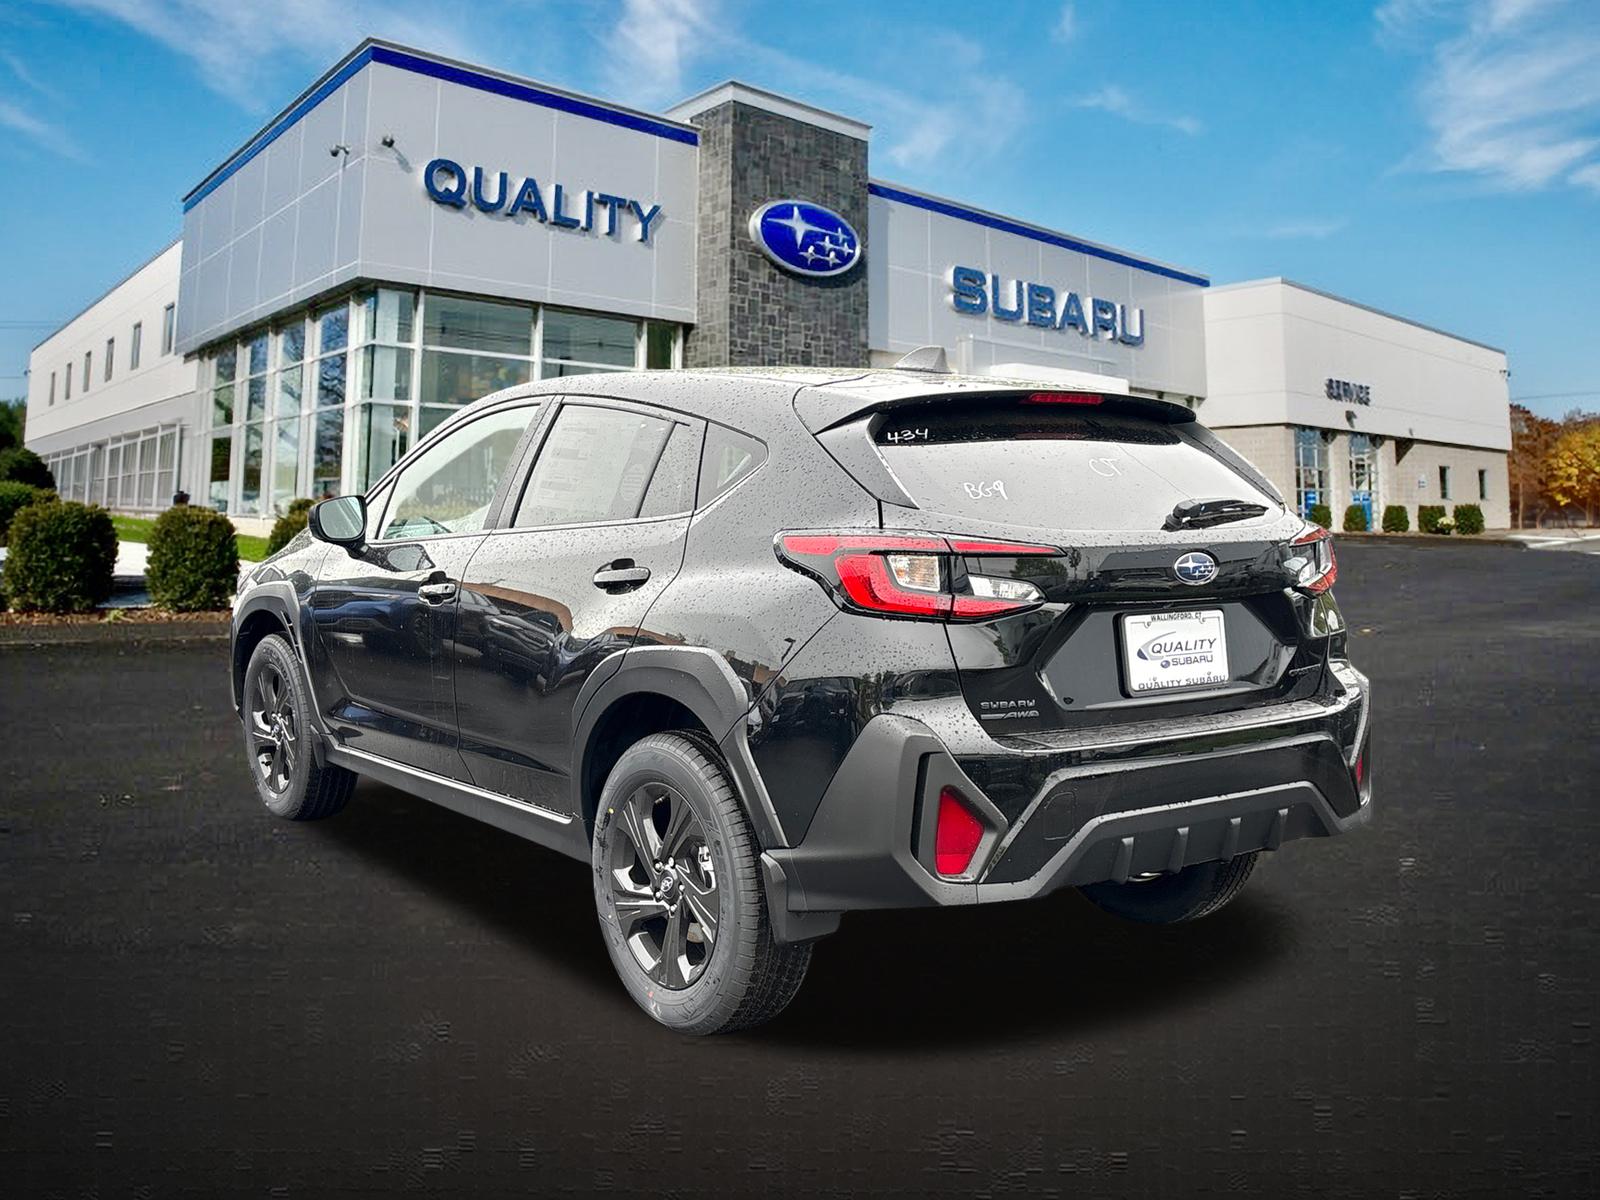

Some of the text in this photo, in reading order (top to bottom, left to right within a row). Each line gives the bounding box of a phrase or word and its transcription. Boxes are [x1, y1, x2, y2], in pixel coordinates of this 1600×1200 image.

[423, 158, 661, 243] QUALITY
[950, 265, 1145, 347] SUBARU
[1326, 378, 1371, 406] SERVICE
[887, 428, 929, 443] 434
[1151, 638, 1217, 654] QUALITY
[1171, 655, 1214, 666] SUBARU
[1138, 675, 1226, 690] QUALITY SUBARU
[980, 699, 1036, 709] SUBARU
[1004, 710, 1039, 719] AWD
